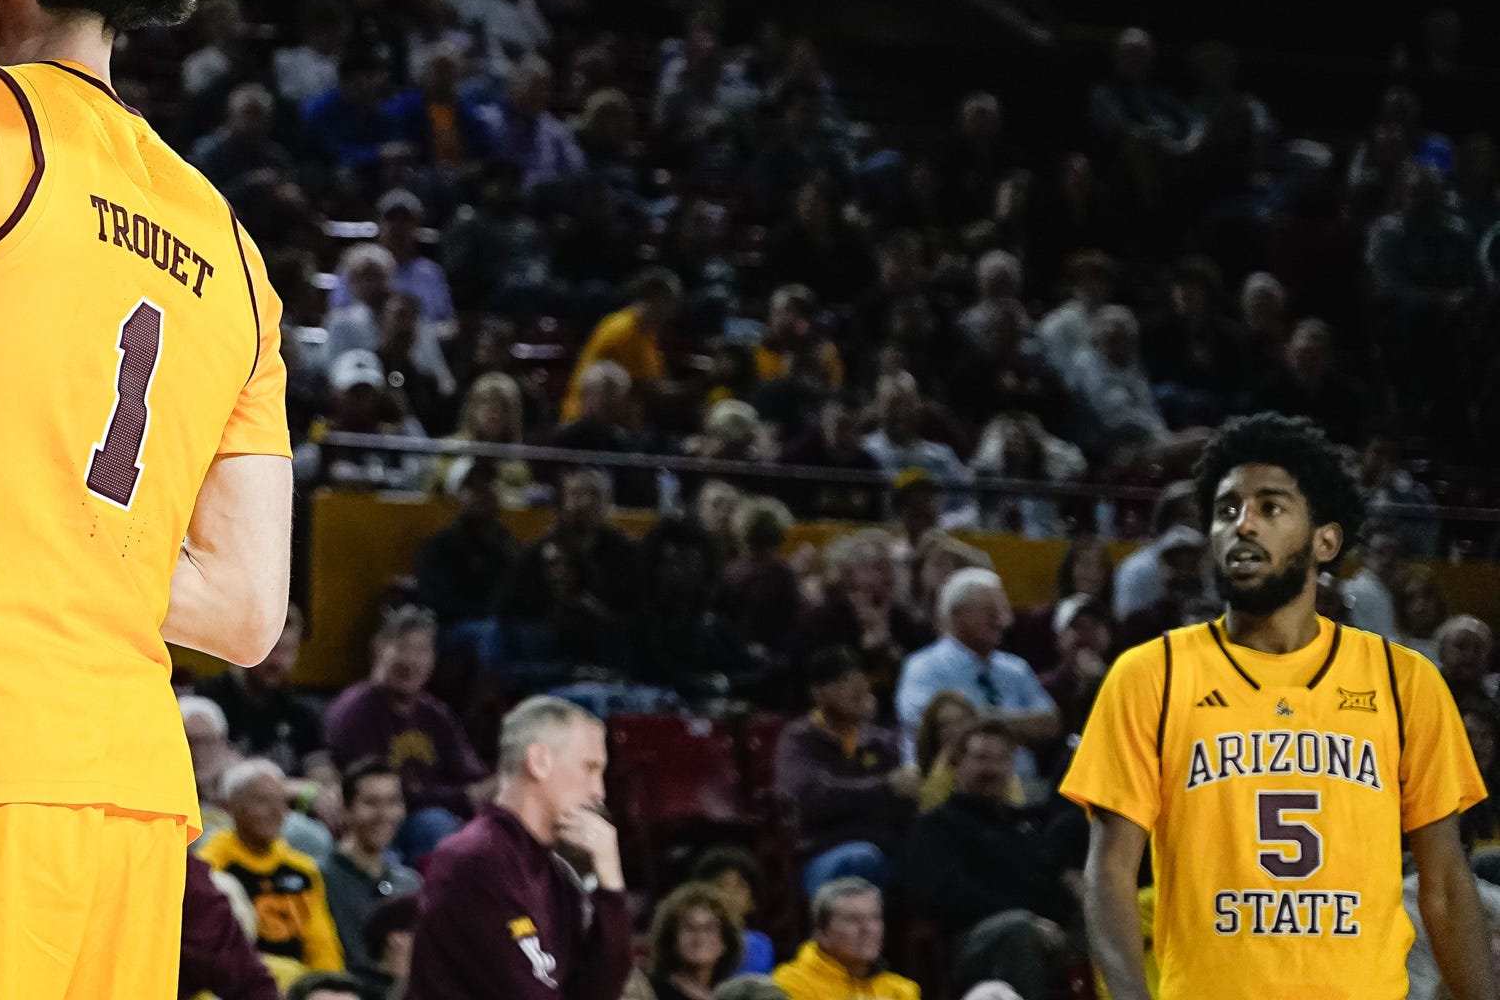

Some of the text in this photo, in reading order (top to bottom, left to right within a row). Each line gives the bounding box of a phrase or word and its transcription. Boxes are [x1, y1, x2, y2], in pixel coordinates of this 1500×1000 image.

[90, 194, 214, 298] TROUET
[84, 296, 165, 512] 1
[1185, 730, 1383, 792] ARIZONA
[1256, 790, 1323, 880] 5
[1214, 889, 1361, 936] STATE
